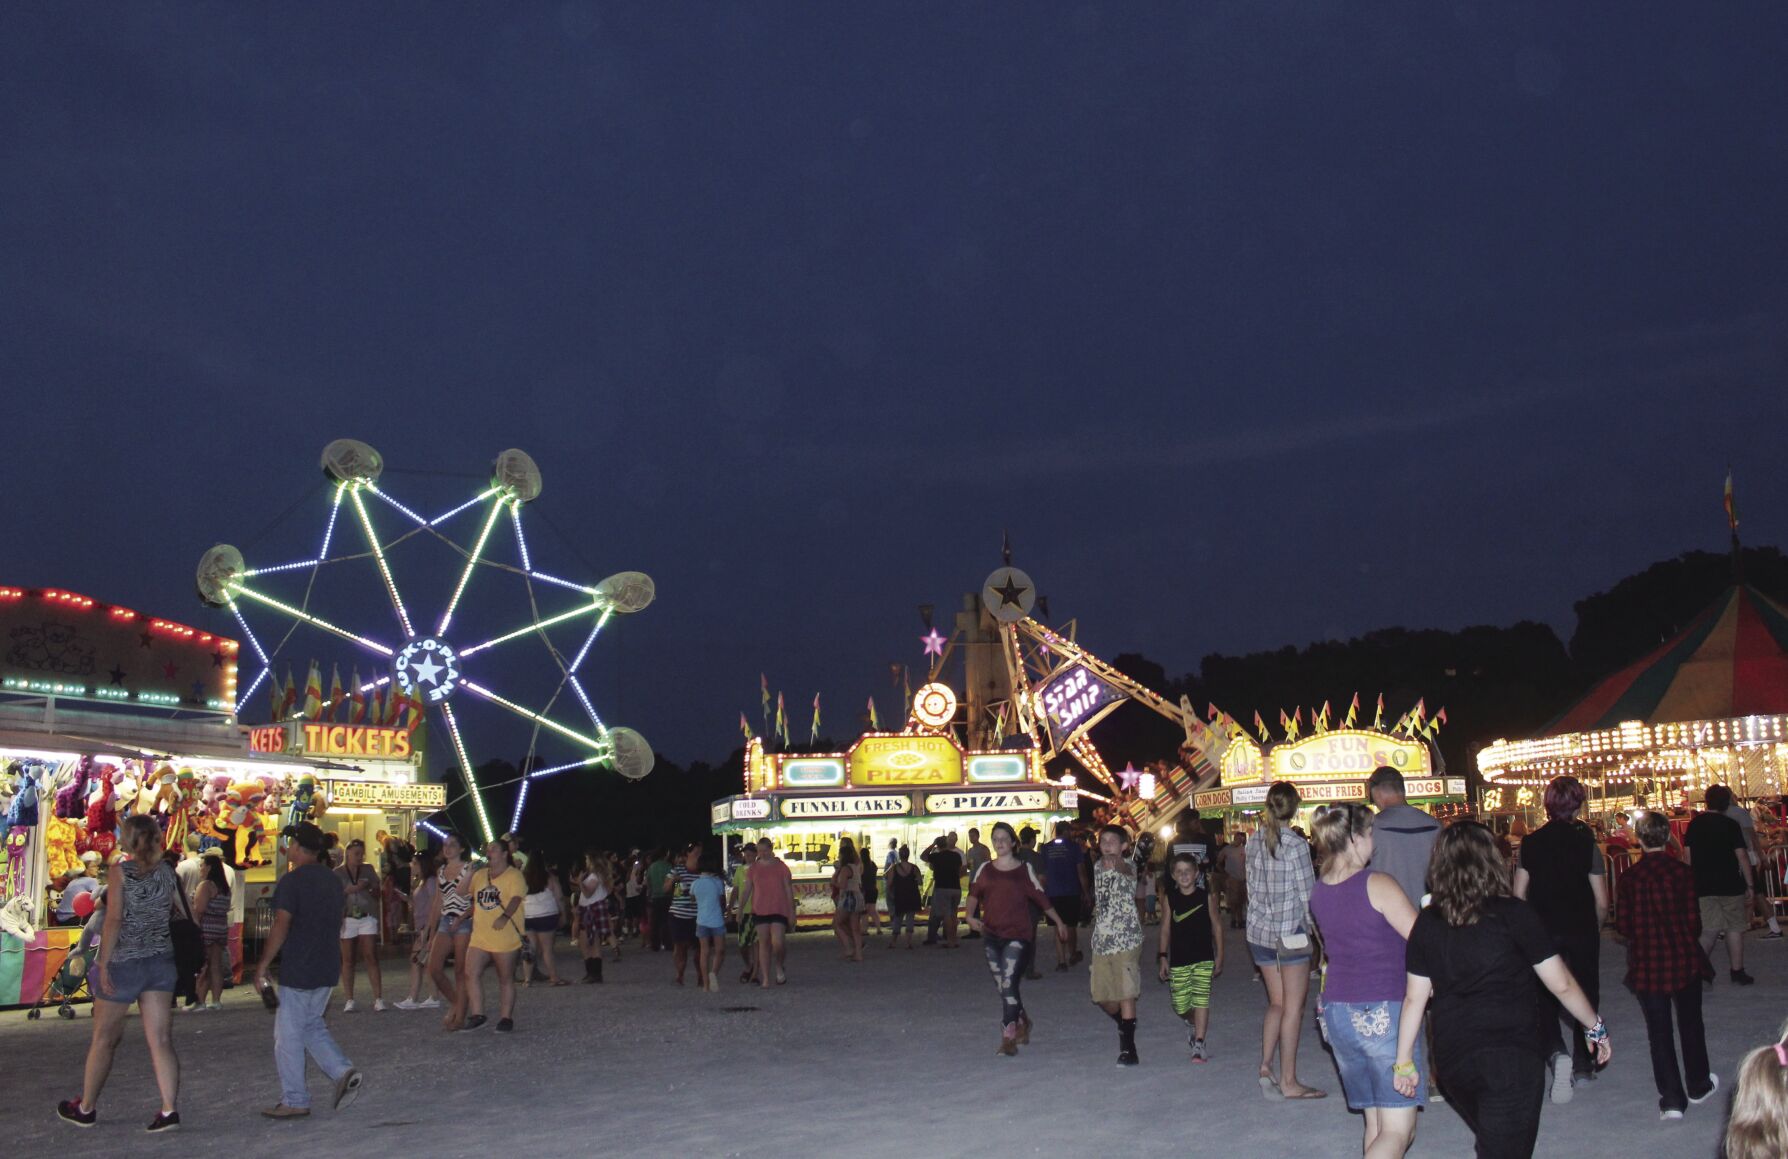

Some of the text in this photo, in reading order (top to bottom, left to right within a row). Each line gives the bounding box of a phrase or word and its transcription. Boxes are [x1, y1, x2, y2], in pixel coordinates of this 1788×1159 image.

[1045, 669, 1088, 713] STAR
[1060, 684, 1099, 727] SHIP
[250, 726, 283, 753] KETS
[304, 724, 411, 757] TICKETS
[864, 741, 946, 753] FRESH HOT
[1327, 737, 1370, 753] FUN
[1312, 750, 1388, 770] FOODS
[866, 768, 943, 782] PIZZA
[338, 787, 438, 800] GAMBILL AMUSEMENTS
[1336, 785, 1363, 797] FRIES
[1407, 781, 1441, 793] DOGS
[739, 801, 757, 809] COLD
[791, 798, 902, 814] FUNNEL CAKES
[953, 794, 1023, 809] PIZZA
[1196, 791, 1230, 807] CORN DOGS
[477, 890, 501, 903] PINK
